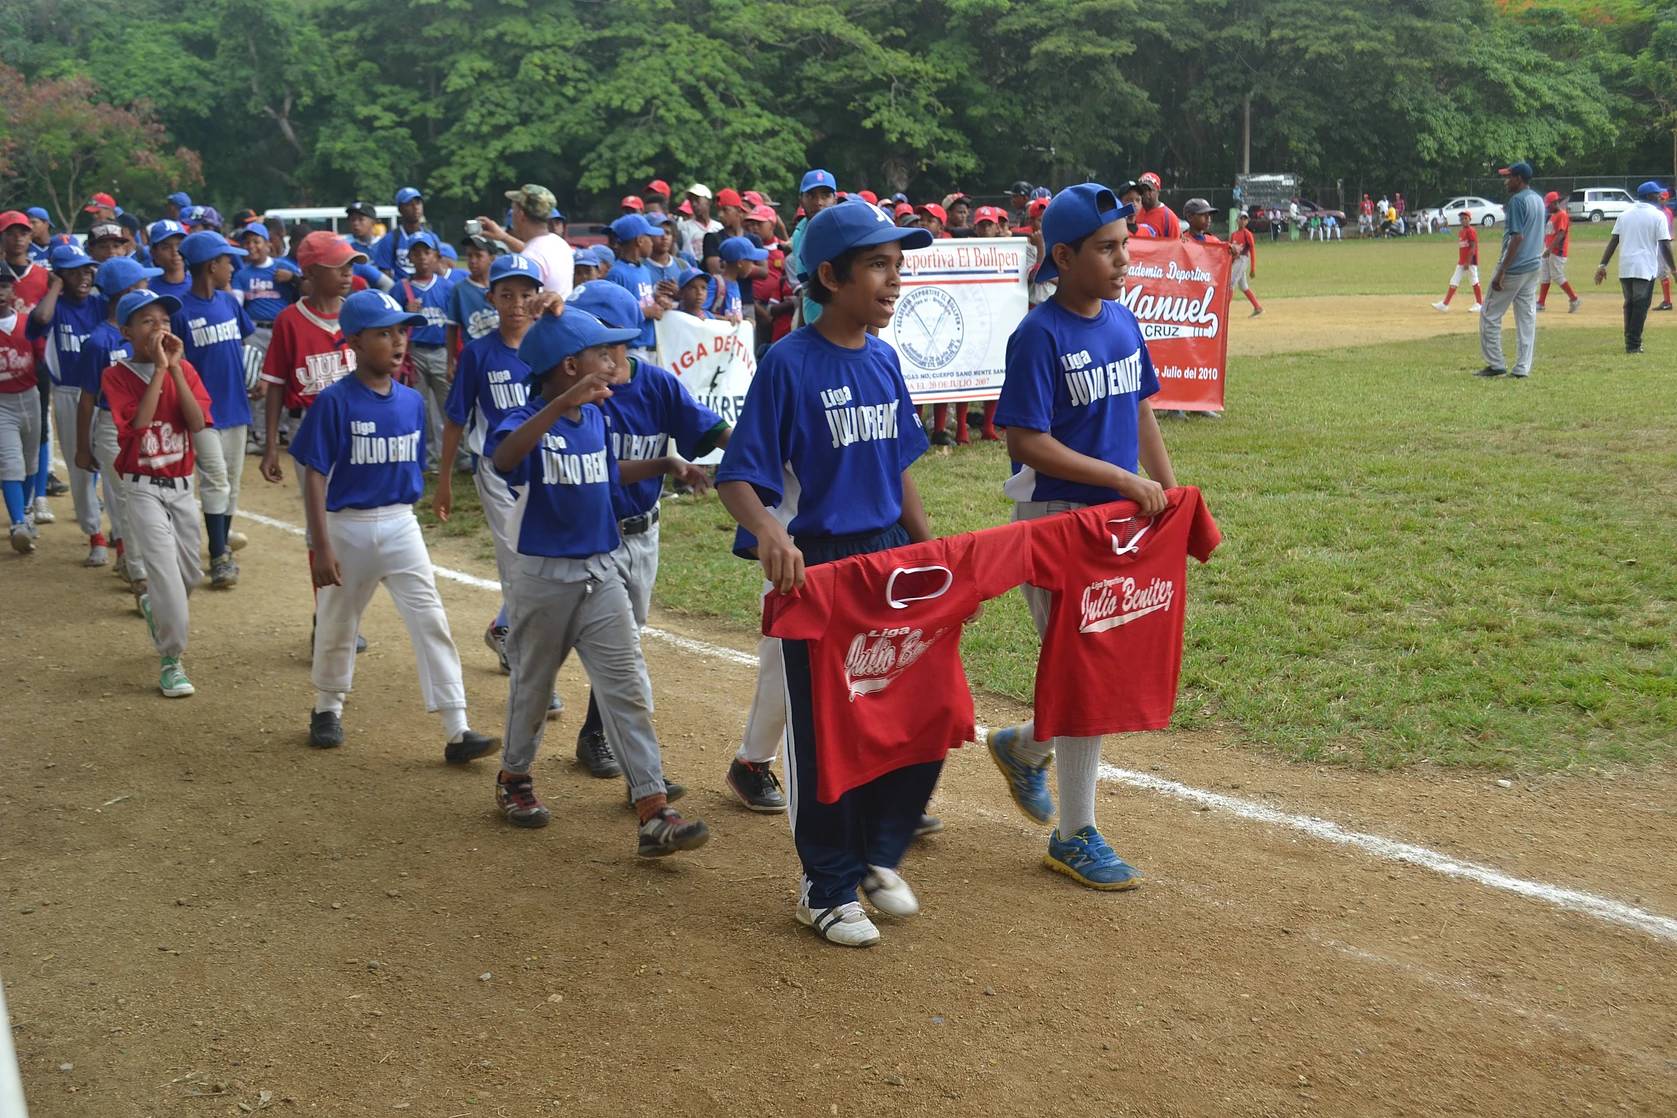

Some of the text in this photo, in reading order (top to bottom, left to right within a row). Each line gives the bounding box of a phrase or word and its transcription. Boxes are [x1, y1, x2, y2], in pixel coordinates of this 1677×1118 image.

[957, 248, 971, 268] El
[973, 247, 1019, 272] Bullpen
[1127, 261, 1212, 284] ademia Deportiva
[1115, 285, 1219, 332] Manuel
[1144, 325, 1179, 337] CRUZ
[1060, 350, 1092, 371] Liga
[488, 370, 511, 383] Liga
[949, 378, 973, 388] JULIO
[1161, 366, 1182, 378] Julio
[1184, 367, 1197, 379] del
[1198, 368, 1218, 380] 2010
[490, 383, 526, 409] JULIO
[820, 386, 852, 408] Liga
[350, 421, 376, 436] Liga
[350, 436, 387, 464] JULIO
[1080, 577, 1174, 630] Julio Benitez
[867, 626, 911, 638] Liga
